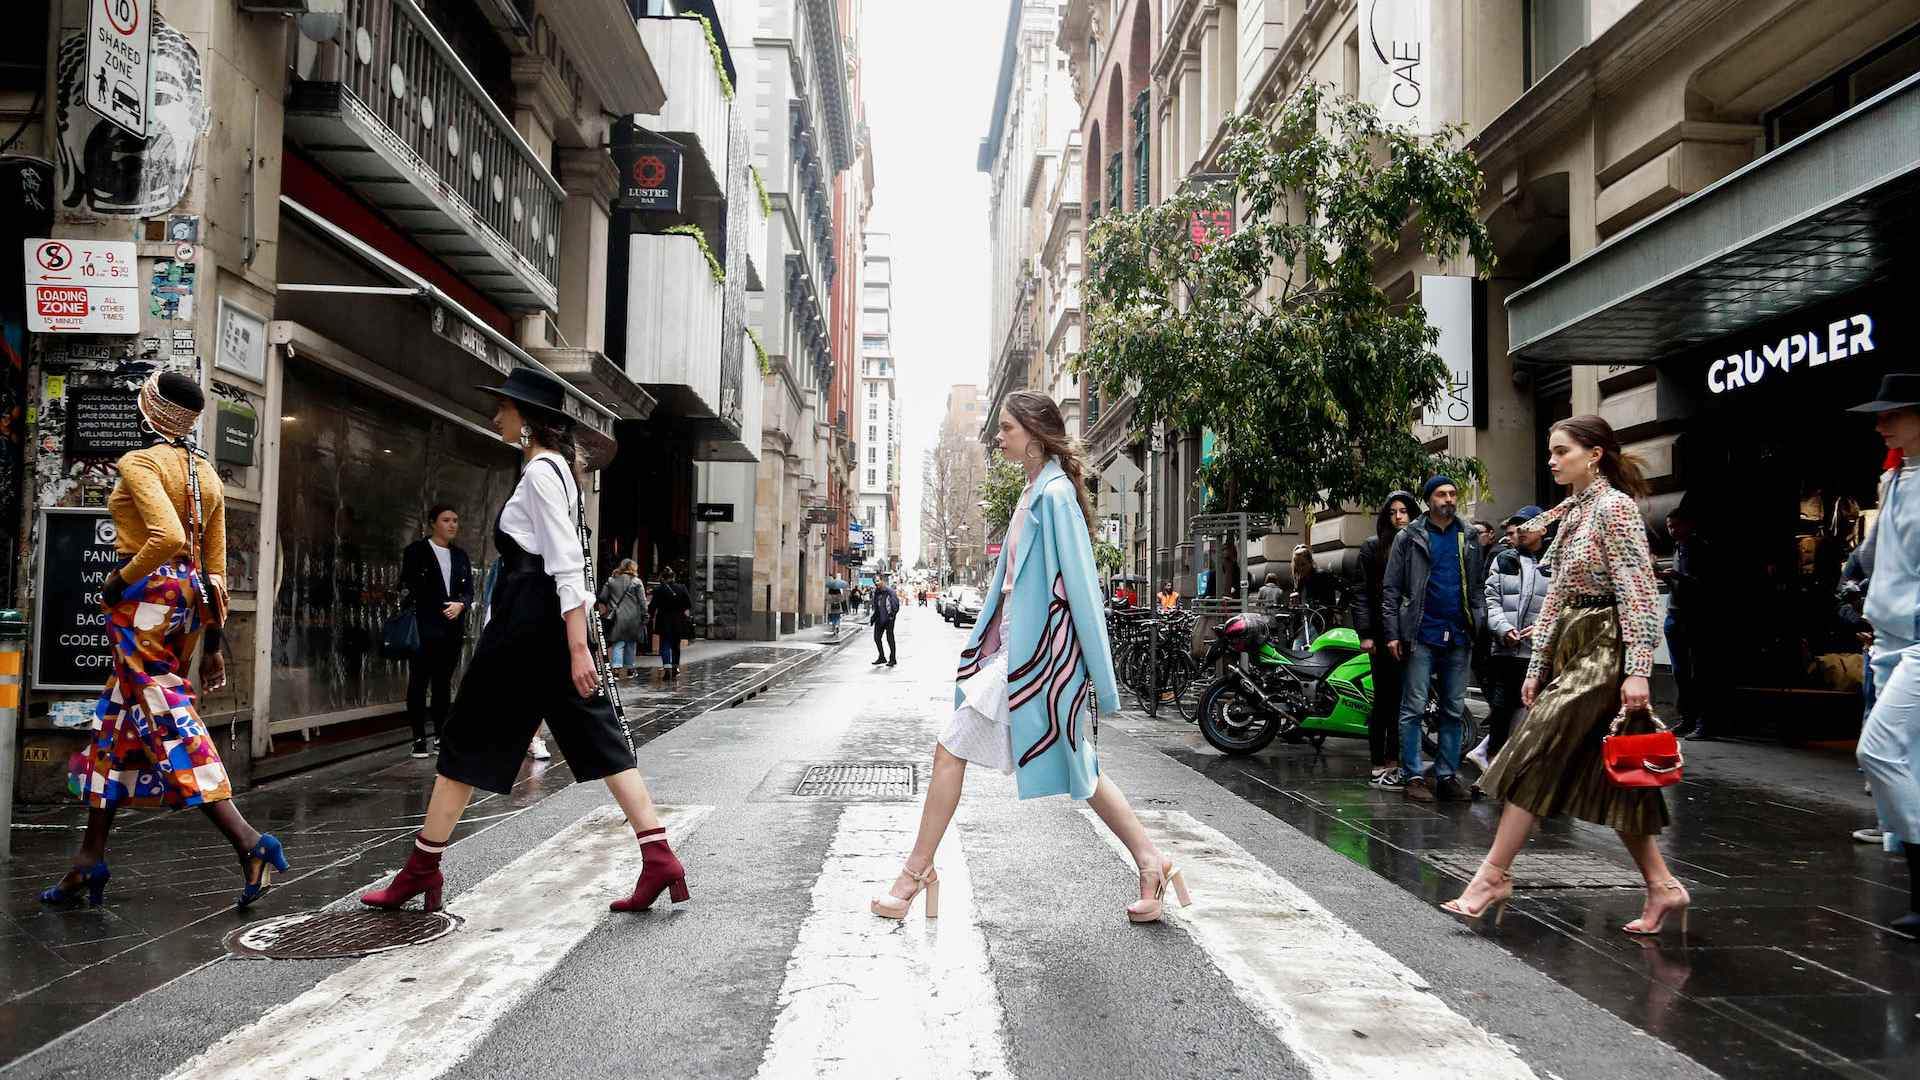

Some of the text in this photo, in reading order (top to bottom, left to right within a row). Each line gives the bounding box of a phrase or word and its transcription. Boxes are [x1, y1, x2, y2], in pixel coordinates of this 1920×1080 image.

[115, 0, 130, 22] 10
[98, 27, 141, 65] SHARED
[105, 50, 132, 80] ZONE
[1392, 40, 1420, 108] CAE
[628, 188, 669, 198] LUSTRE
[82, 251, 92, 262] 7
[105, 252, 114, 263] 9
[80, 265, 95, 277] 10
[111, 266, 118, 277] 5
[38, 290, 87, 302] LOADING
[41, 302, 85, 313] ZONE
[1708, 313, 1875, 394] CRUMPLER
[1448, 370, 1469, 422] CAE
[76, 614, 106, 626] BAG
[60, 634, 110, 646] CODE B
